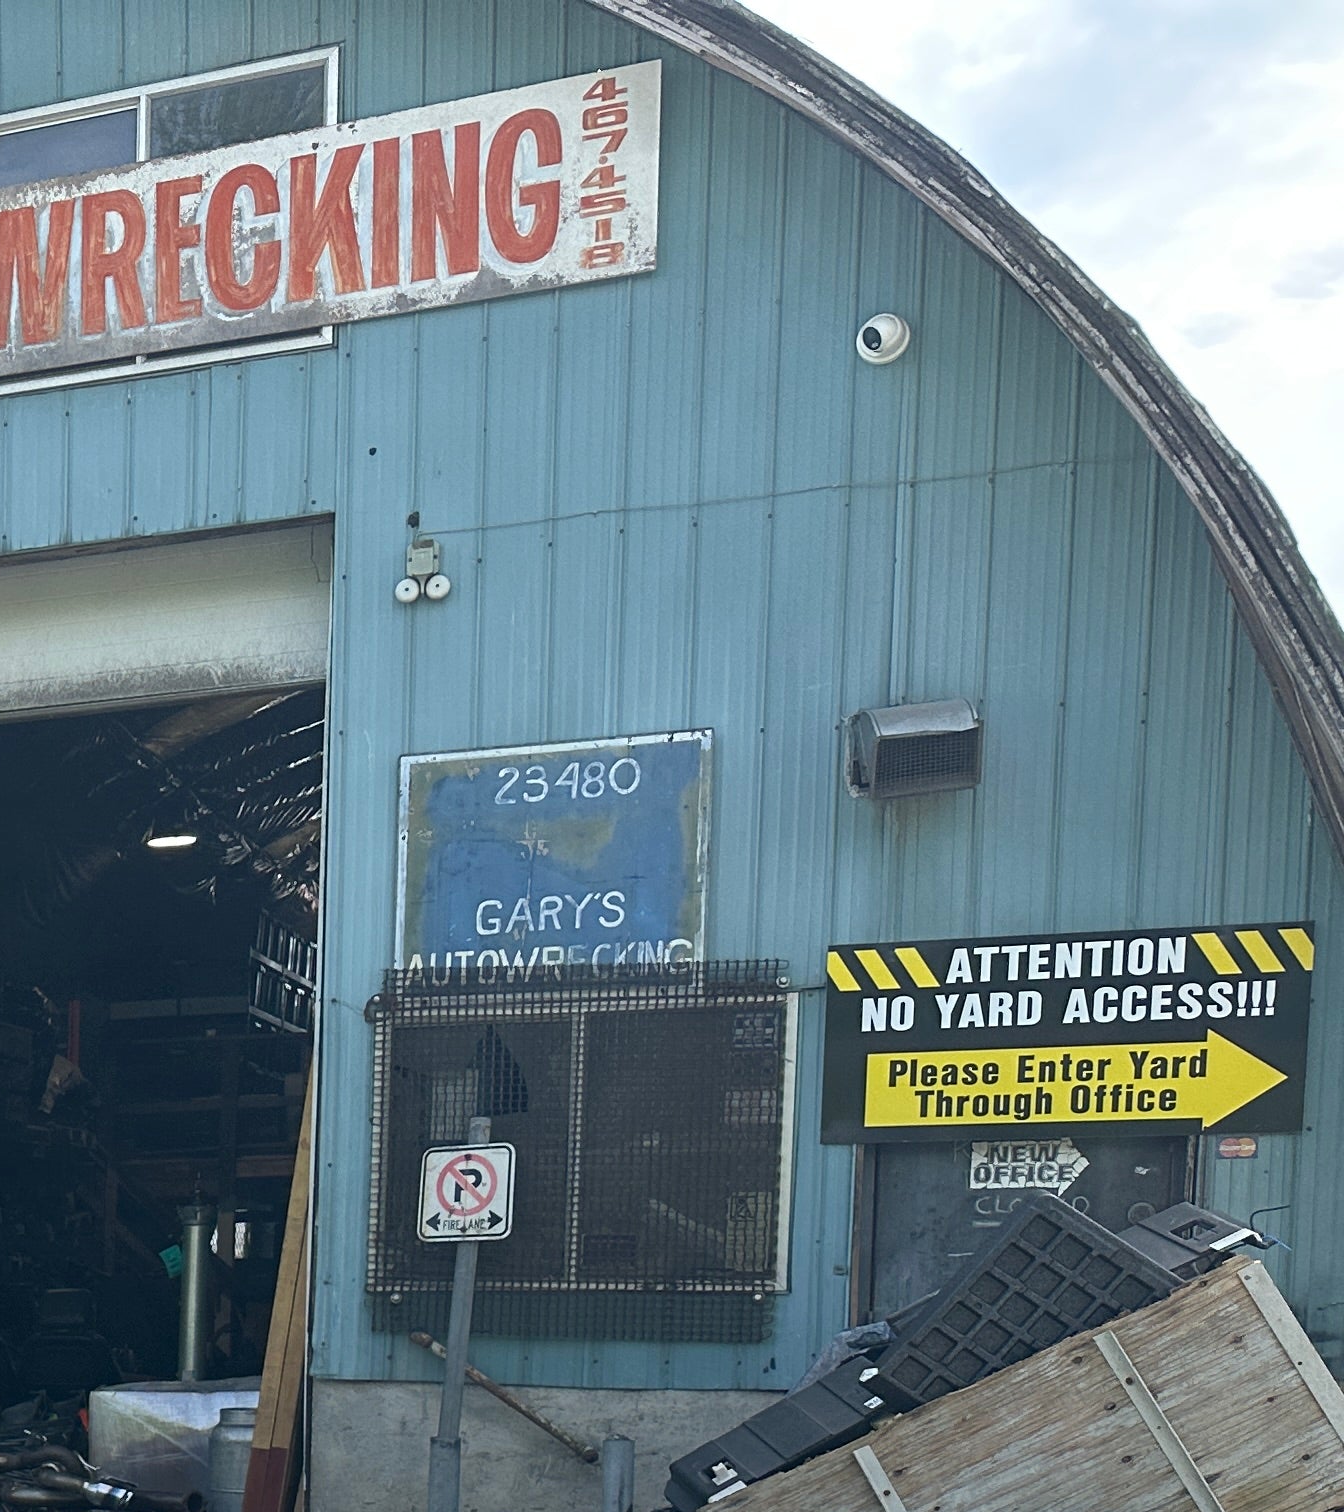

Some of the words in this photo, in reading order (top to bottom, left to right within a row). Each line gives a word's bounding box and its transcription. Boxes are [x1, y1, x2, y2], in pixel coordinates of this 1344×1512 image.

[494, 757, 642, 805] 23480
[475, 890, 627, 936] GARY'S
[945, 936, 1188, 985] ATTENTION
[860, 995, 915, 1033] NO
[934, 989, 1043, 1030] YARD
[1062, 979, 1278, 1024] ACCESS!!!
[888, 1058, 1000, 1088] Please
[1016, 1053, 1112, 1084] Enter
[1128, 1048, 1209, 1081] Yard
[914, 1086, 1053, 1120] Through
[1070, 1083, 1178, 1114] Office
[989, 1144, 1059, 1164] NEW
[973, 1164, 1075, 1185] OFFICE
[442, 1219, 461, 1231] FIRE
